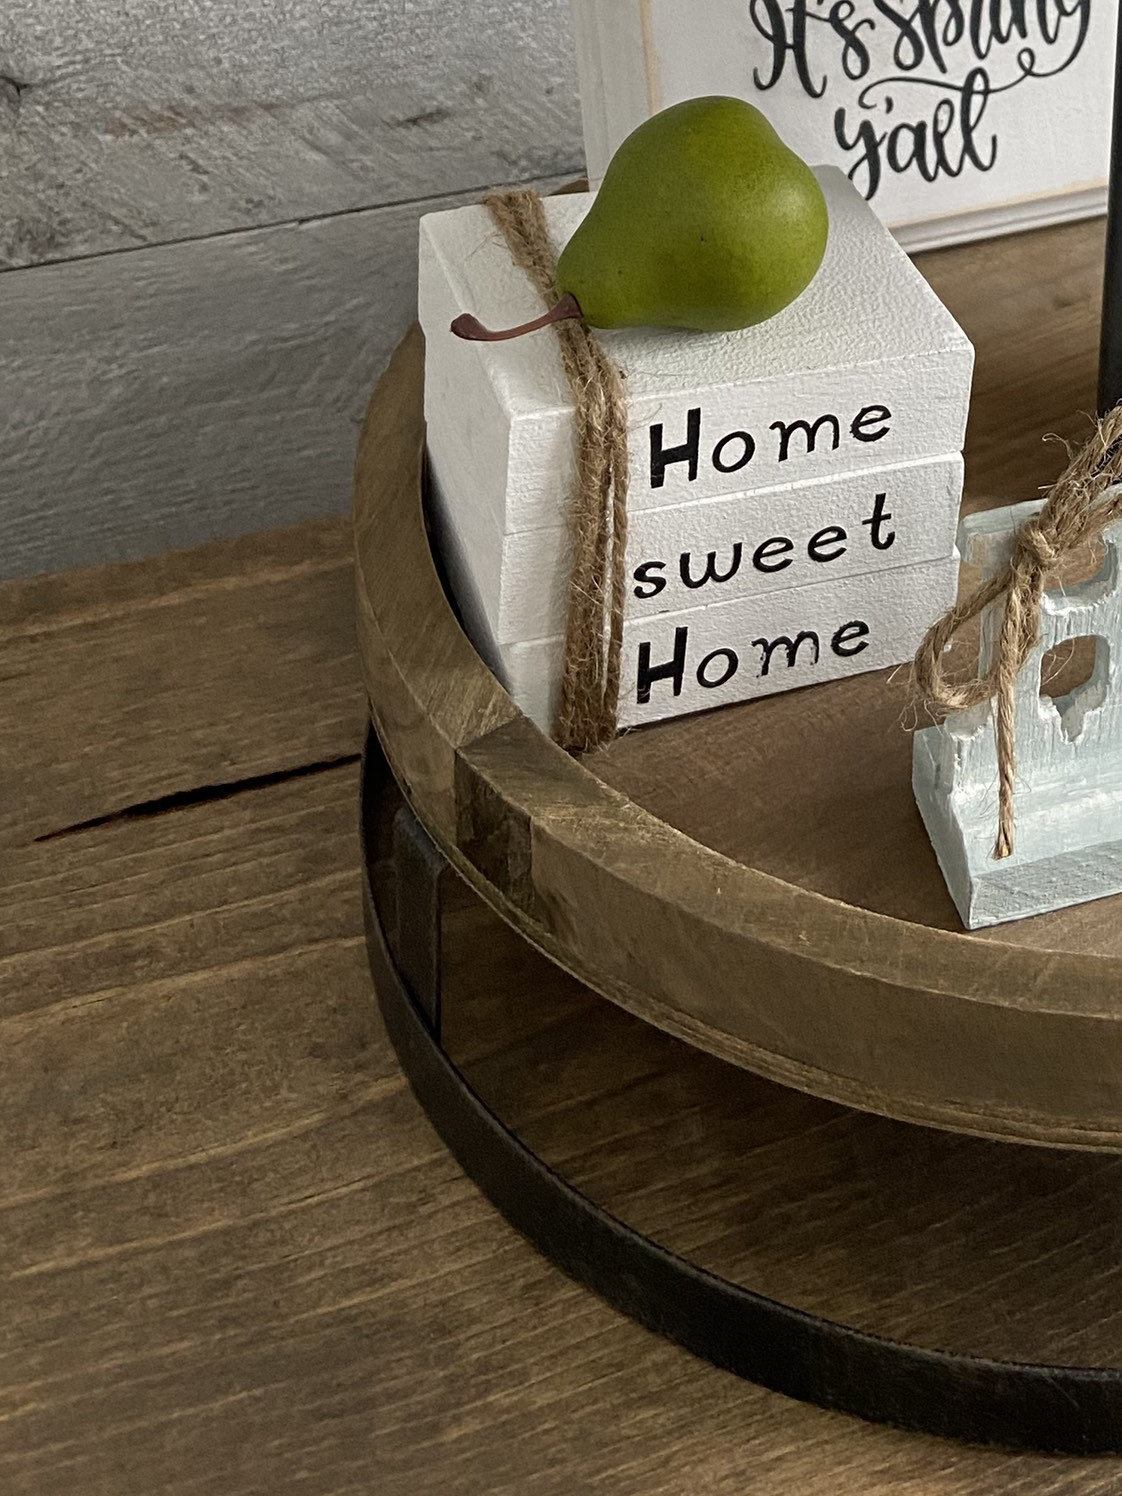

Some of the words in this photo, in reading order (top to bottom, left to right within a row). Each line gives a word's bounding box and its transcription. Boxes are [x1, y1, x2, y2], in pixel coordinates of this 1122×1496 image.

[833, 67, 998, 200] y'all
[649, 407, 892, 489] Home
[633, 492, 896, 599] sweet
[636, 619, 870, 704] Home
